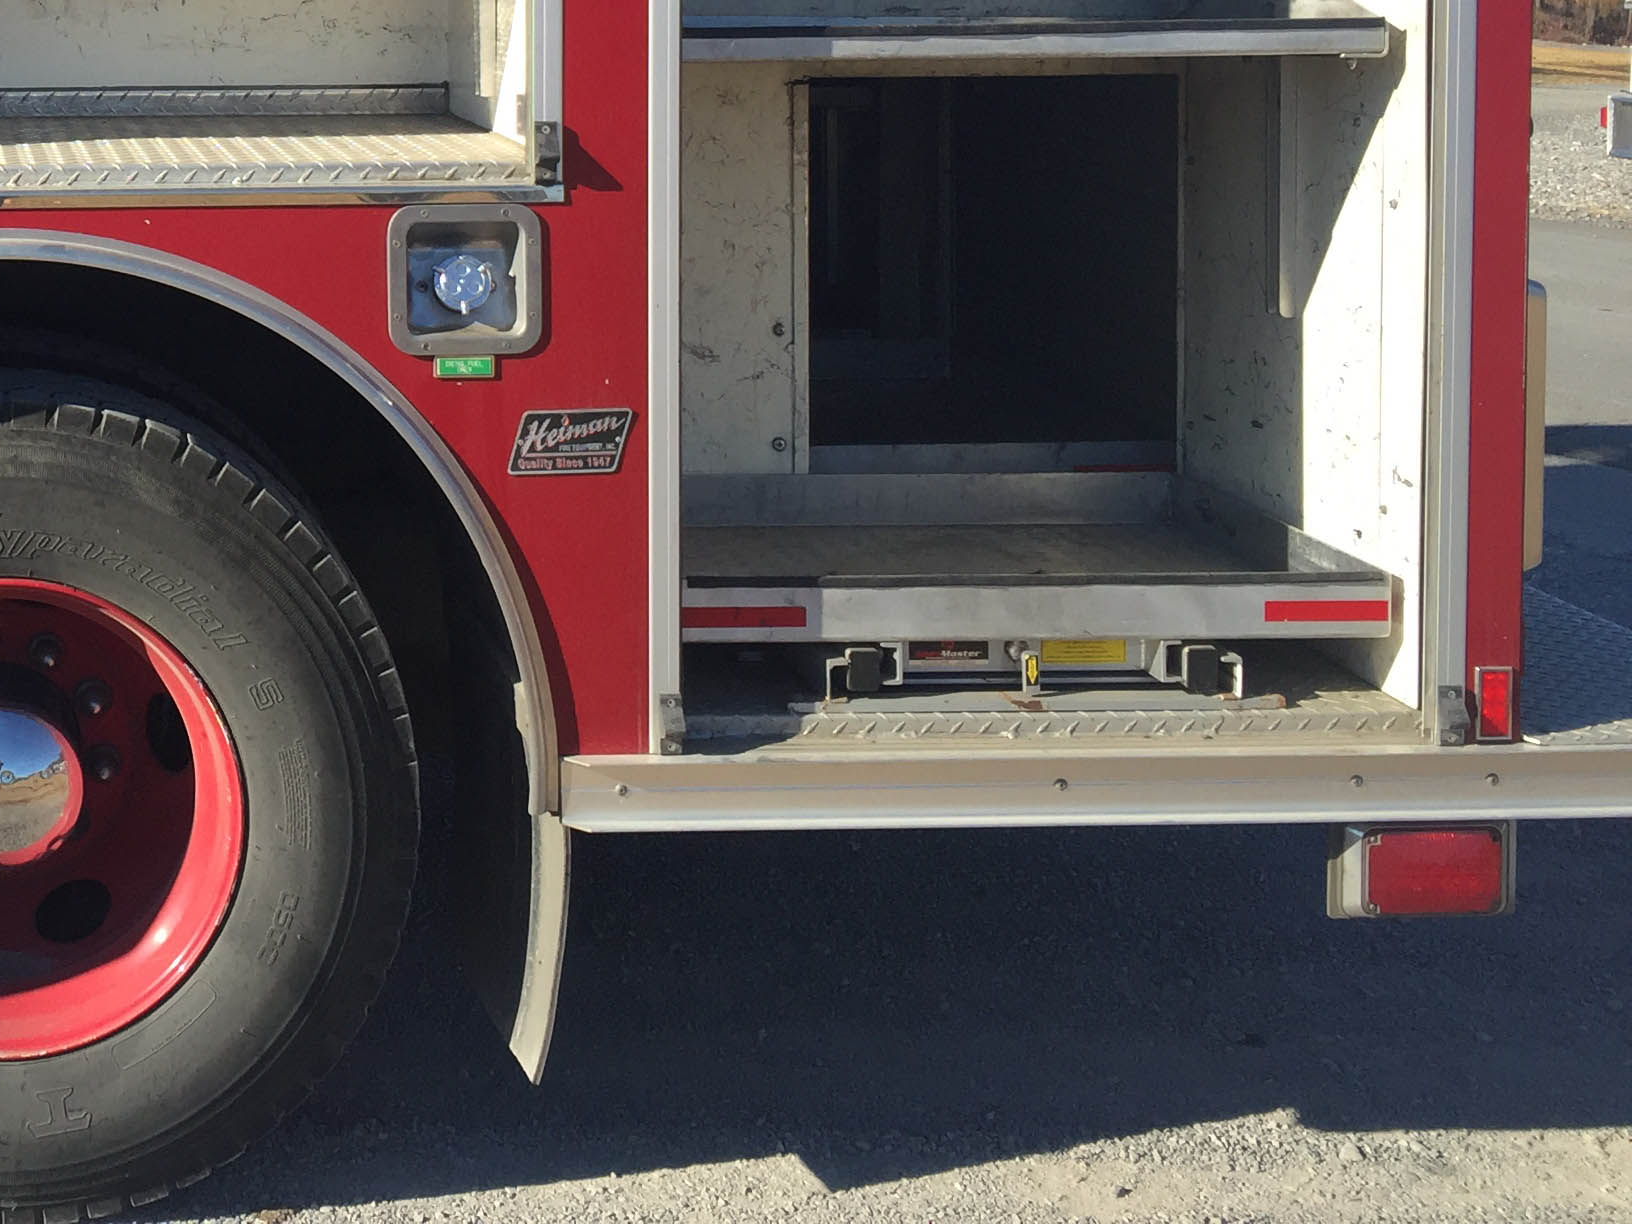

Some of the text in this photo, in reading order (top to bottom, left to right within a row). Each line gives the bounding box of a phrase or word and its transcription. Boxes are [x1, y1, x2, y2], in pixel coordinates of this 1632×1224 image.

[520, 415, 625, 457] Heiman
[517, 458, 553, 470] Quality
[556, 457, 583, 468] Since
